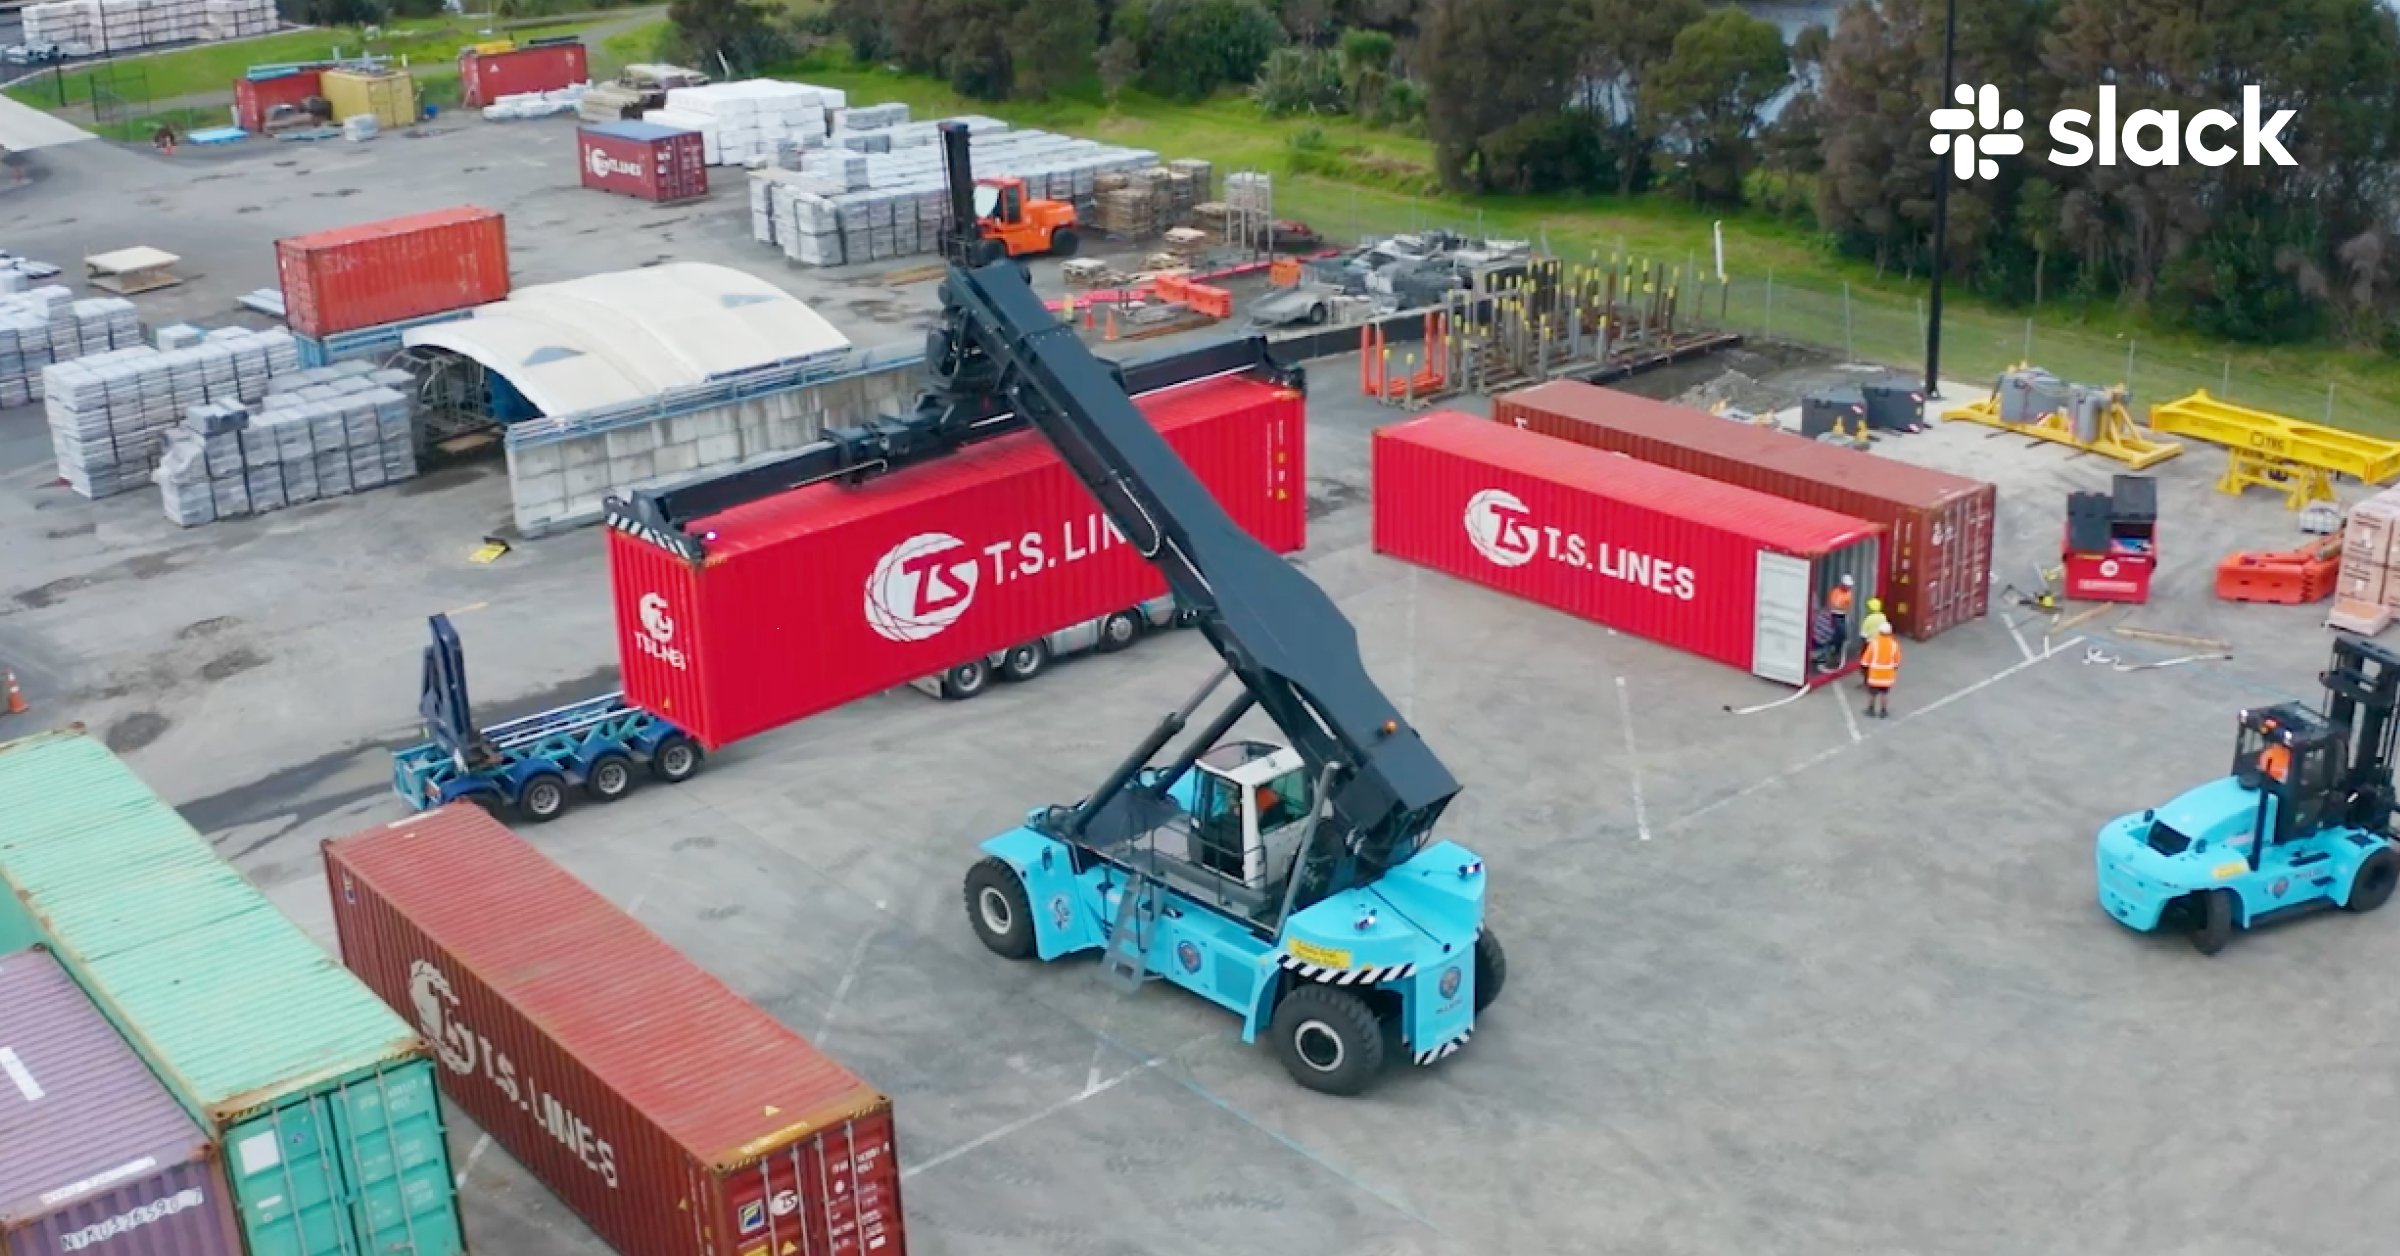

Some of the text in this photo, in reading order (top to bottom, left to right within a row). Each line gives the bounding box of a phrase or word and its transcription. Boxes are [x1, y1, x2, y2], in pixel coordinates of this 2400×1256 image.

[983, 512, 1126, 585] T.S. LIN
[1544, 525, 1695, 600] T.S. LINES
[529, 1076, 618, 1189] LINES
